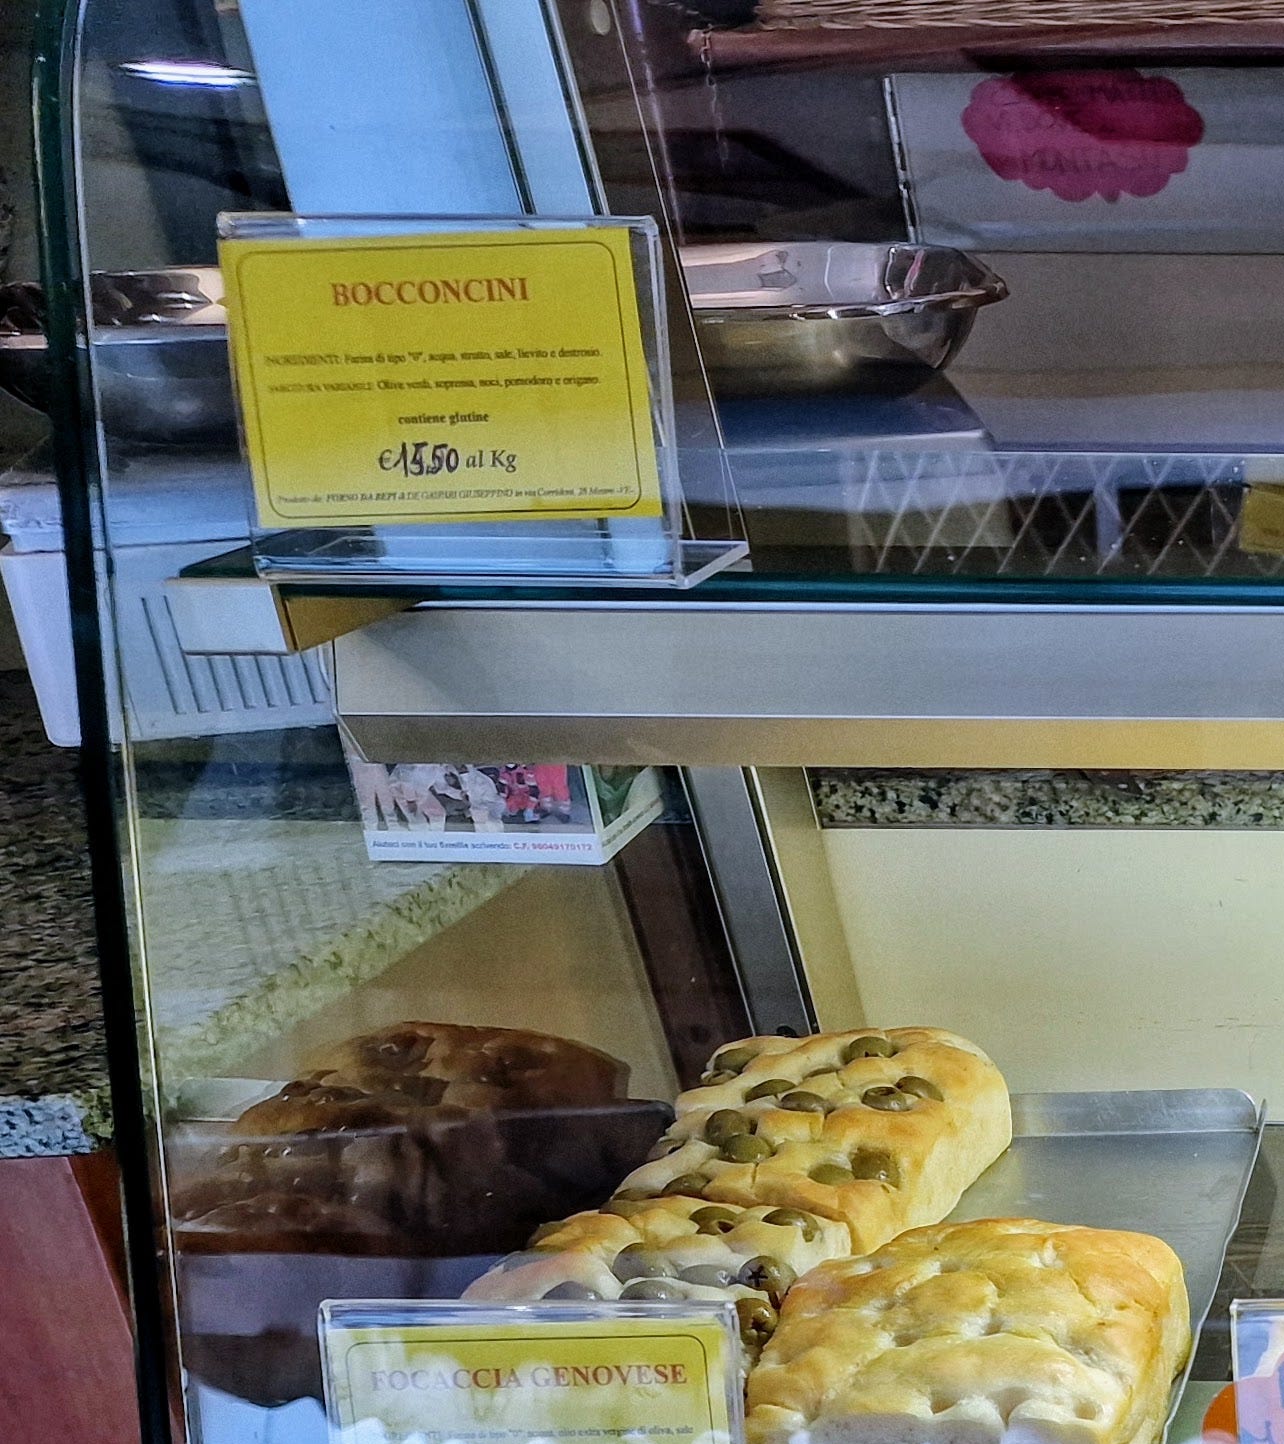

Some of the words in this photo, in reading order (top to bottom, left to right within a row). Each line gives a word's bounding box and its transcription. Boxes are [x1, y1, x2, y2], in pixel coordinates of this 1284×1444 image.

[331, 277, 531, 307] BOCCONCINI
[398, 413, 446, 425] contiene
[450, 411, 490, 426] glutine
[466, 449, 485, 468] al
[490, 450, 518, 474] Kg
[371, 1367, 522, 1391] FOCACCIA
[531, 1363, 687, 1388] GENOVESE
